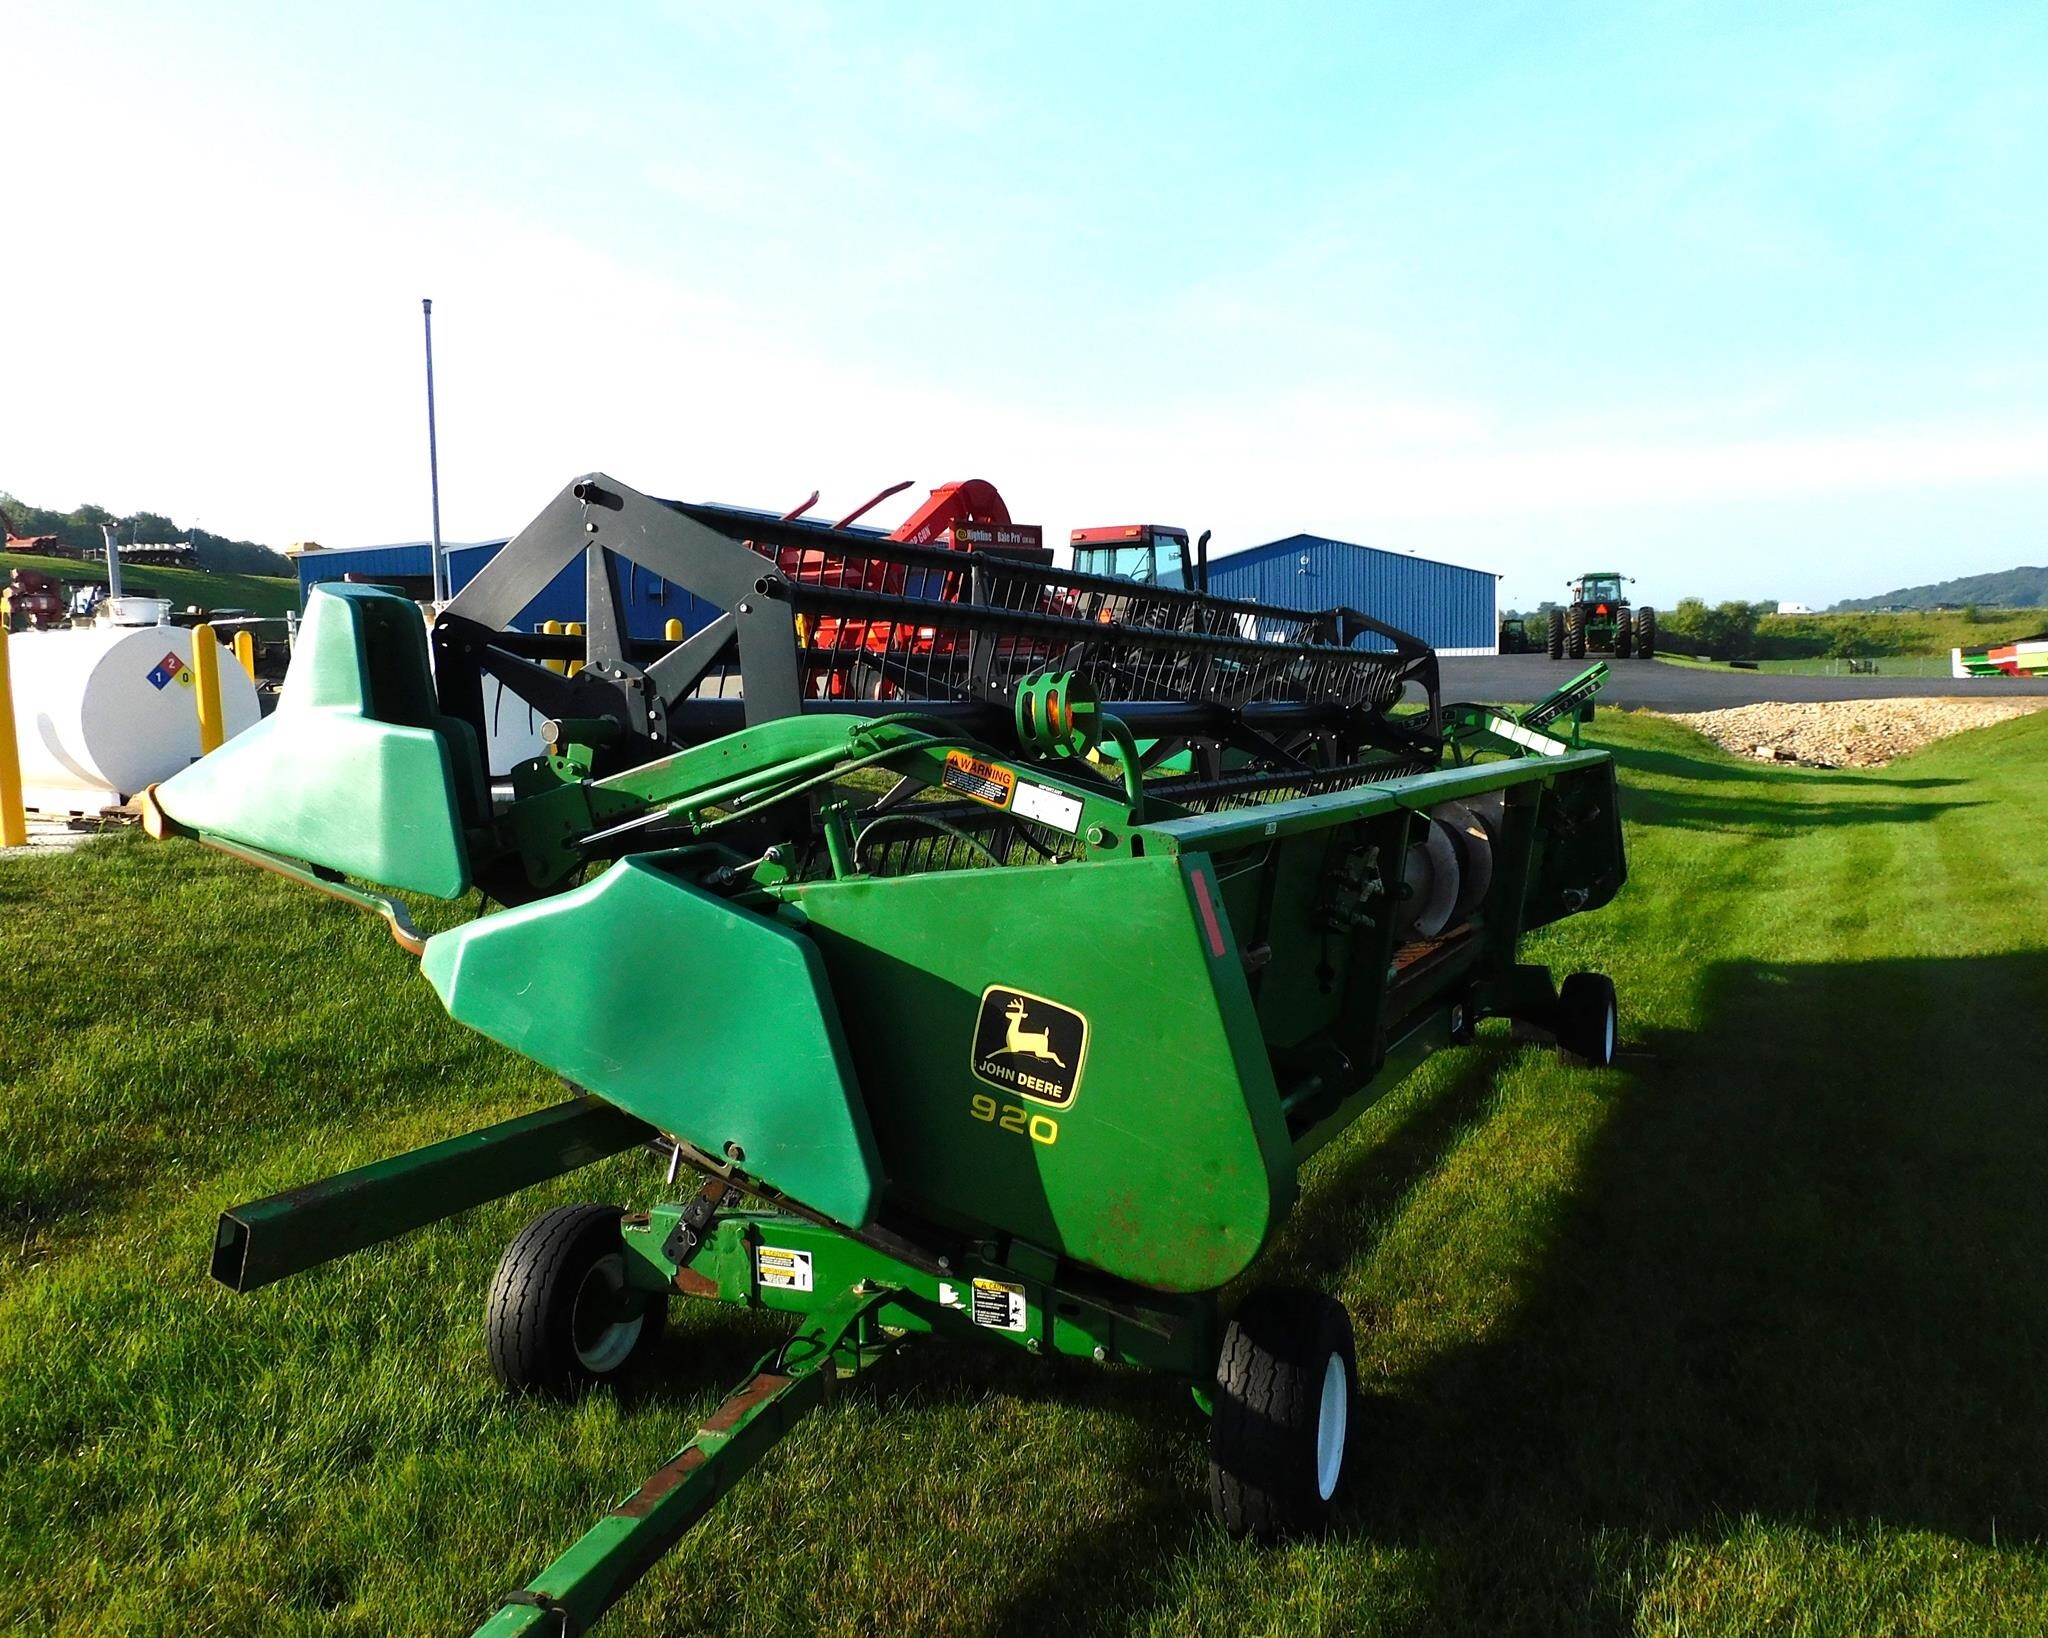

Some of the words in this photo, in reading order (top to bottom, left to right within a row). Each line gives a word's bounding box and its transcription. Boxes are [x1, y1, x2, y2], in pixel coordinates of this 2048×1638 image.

[917, 525, 931, 544] GUN
[1011, 531, 1021, 544] Pro
[168, 658, 176, 669] 2
[155, 672, 161, 682] 1
[182, 672, 189, 683] 0
[960, 757, 1011, 785] WARNING
[979, 1060, 1016, 1082] JOHN
[1017, 1072, 1063, 1099] DEERE
[970, 1093, 1058, 1145] 920
